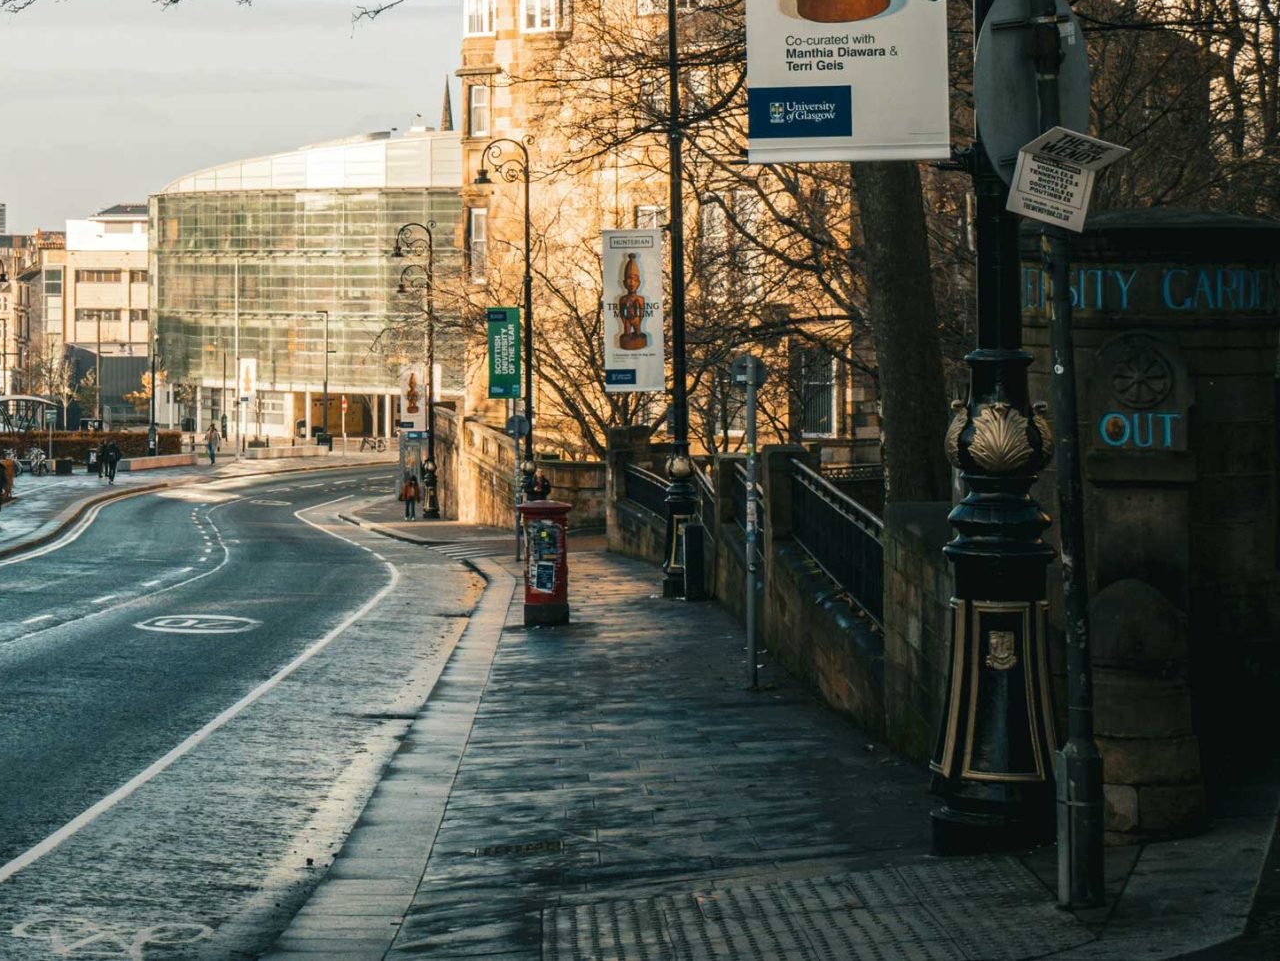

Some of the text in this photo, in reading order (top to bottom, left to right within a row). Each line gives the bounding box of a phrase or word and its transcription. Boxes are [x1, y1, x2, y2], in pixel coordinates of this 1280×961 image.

[785, 34, 875, 46] Co-curated with
[786, 45, 898, 59] Manthia Diawara &
[786, 60, 844, 71] Terri Geis
[786, 101, 836, 112] University
[786, 110, 836, 123] of Glasgow
[1055, 133, 1091, 149] THE
[1040, 141, 1103, 164] WENDY
[507, 324, 515, 346] YEAR
[1099, 411, 1182, 448] OUT
